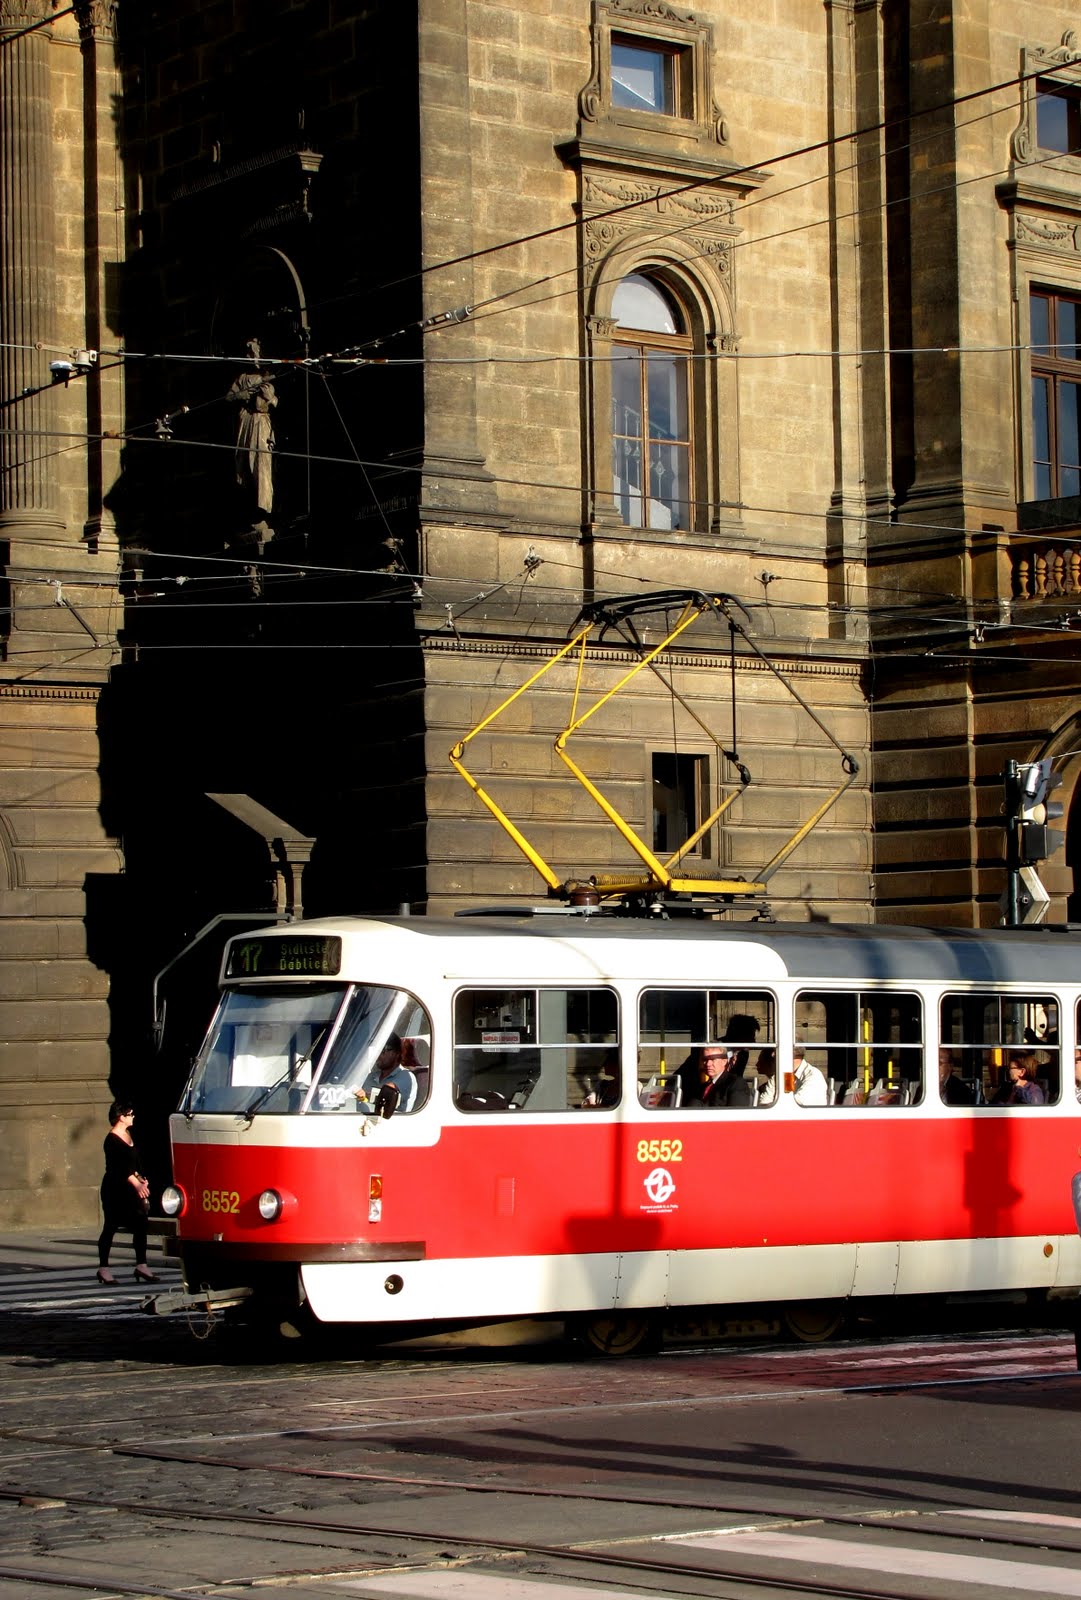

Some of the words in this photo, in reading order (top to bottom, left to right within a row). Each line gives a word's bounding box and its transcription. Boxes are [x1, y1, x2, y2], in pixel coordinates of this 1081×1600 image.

[240, 943, 263, 972] 17
[636, 1139, 683, 1163] 8552
[202, 1189, 240, 1214] 8552
